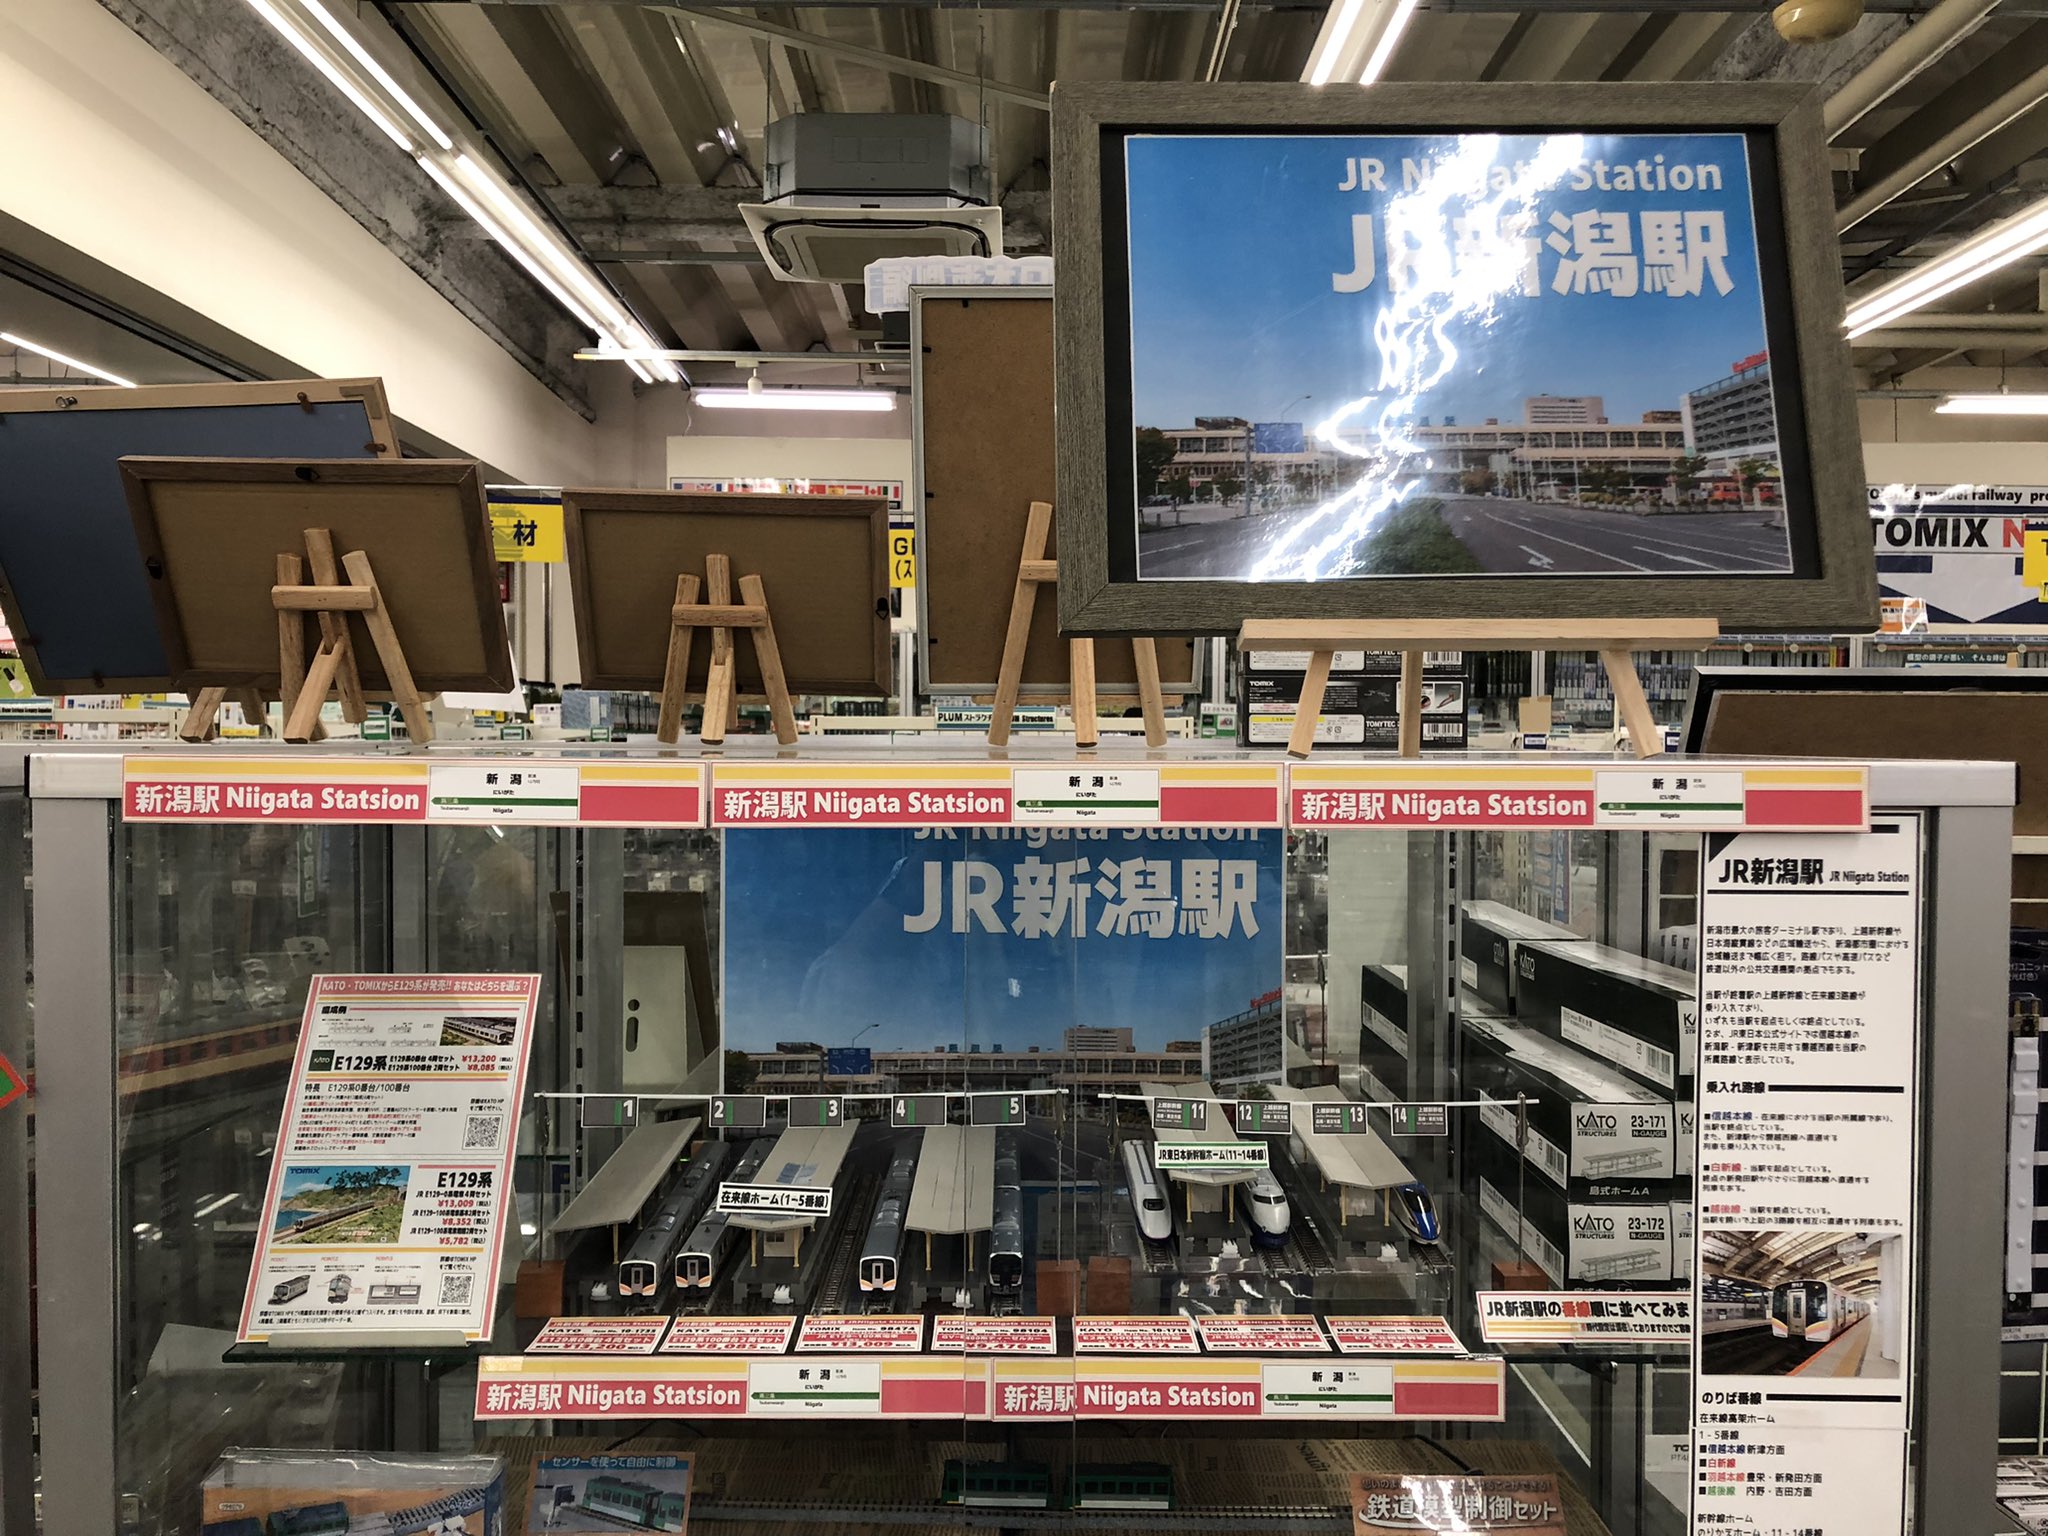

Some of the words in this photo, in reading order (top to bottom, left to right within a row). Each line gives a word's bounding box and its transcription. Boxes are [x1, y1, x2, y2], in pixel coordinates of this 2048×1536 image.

[1338, 158, 1386, 192] JR
[1570, 154, 1723, 192] Station
[1972, 489, 2022, 503] railway
[513, 519, 536, 547] 材
[1871, 518, 1989, 548] TOMIX
[938, 713, 962, 721] PLUM
[135, 785, 219, 813] 新潟駅
[226, 788, 314, 816] Niigata
[321, 787, 418, 811] Statsion
[724, 791, 807, 819] 新潟駅
[813, 792, 901, 818] Niigata
[908, 792, 1004, 814] Statsion
[1302, 793, 1383, 821] 新潟駅
[1391, 794, 1480, 821] Niigata
[1488, 793, 1587, 816] Statsion
[1718, 859, 1823, 885] JR新潟駅
[1829, 872, 1840, 882] JR
[1843, 872, 1875, 884] Niigata
[1878, 872, 1909, 882] Station
[904, 856, 1260, 940] JR新潟駅
[334, 1056, 388, 1070] E129系
[462, 1055, 496, 1063] ¥13,200
[305, 1084, 320, 1092] 特長
[328, 1084, 410, 1092] E129系0番台/100番台
[1707, 1082, 1765, 1093] 乗入れ路線
[623, 1101, 633, 1117] 1
[714, 1102, 723, 1118] 2
[828, 1100, 838, 1117] 3
[896, 1100, 905, 1116] 4
[1010, 1098, 1019, 1114] 5
[1192, 1103, 1204, 1119] 11
[1240, 1105, 1252, 1120] 12
[1350, 1107, 1363, 1122] 13
[1394, 1108, 1406, 1123] 14
[1577, 1111, 1616, 1128] KATO
[1631, 1116, 1666, 1128] 23-171
[1712, 1112, 1752, 1121] 信越本線
[1711, 1163, 1741, 1172] 白新線
[438, 1172, 492, 1188] E129系
[1589, 1186, 1649, 1195] 島式ホームA
[442, 1218, 471, 1226] ¥8,352
[1574, 1213, 1614, 1231] KATO
[1628, 1218, 1664, 1229] 23-172
[439, 1237, 468, 1245] ¥5,782
[1487, 1301, 1689, 1318] JR新潟駅の番線順に並べてみま
[487, 1384, 561, 1411] 新潟駅
[568, 1384, 646, 1411] Niigata
[653, 1384, 740, 1406] Statsion
[1004, 1385, 1076, 1412] 新潟駅
[1084, 1385, 1164, 1408] Niigata
[1169, 1385, 1254, 1406] Statsion
[1702, 1392, 1761, 1404] のりば番線
[1700, 1414, 1775, 1423] 在来線高架ホーム
[1715, 1431, 1739, 1440] 5番線
[1709, 1445, 1745, 1454] 信越本線
[1747, 1445, 1785, 1454] 新津方面
[553, 1457, 676, 1468] センサーを使って自由に制御
[1708, 1459, 1736, 1468] 白新線
[1708, 1473, 1744, 1482] 羽越本線
[1746, 1487, 1812, 1497] 内野・吉田方面
[1368, 1494, 1557, 1520] 鉄道模型制御セット
[1698, 1514, 1753, 1523] 新幹線ホーム
